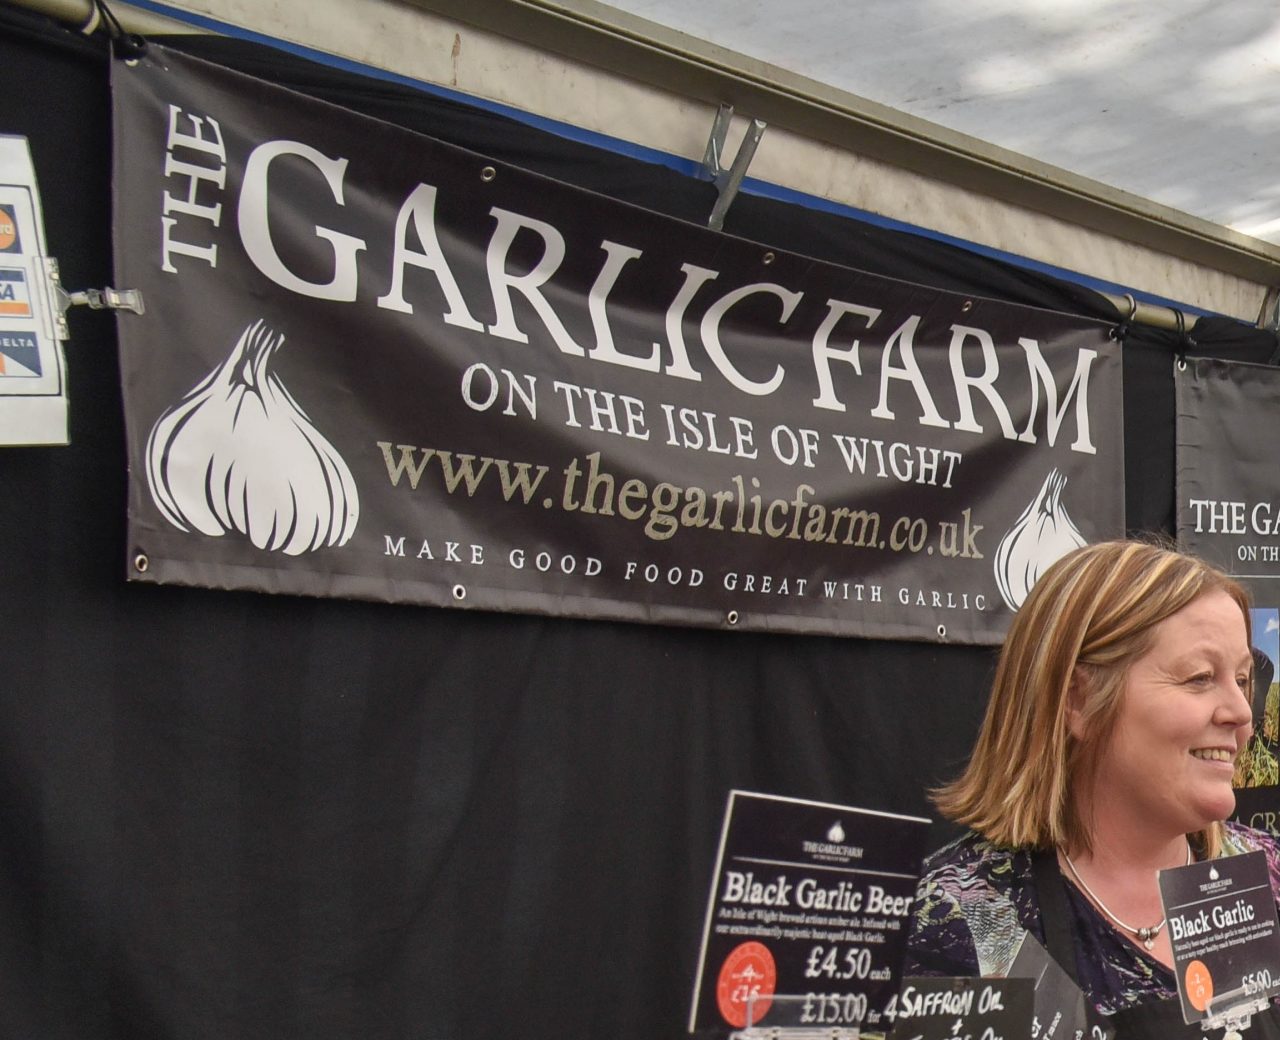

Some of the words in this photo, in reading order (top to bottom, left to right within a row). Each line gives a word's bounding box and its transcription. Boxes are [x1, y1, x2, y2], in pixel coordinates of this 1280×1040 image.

[162, 104, 226, 273] THE
[461, 362, 539, 420] ON
[553, 381, 650, 441] THE
[661, 404, 759, 461] ISLE
[771, 425, 819, 468] OF
[832, 435, 962, 490] WIGHT
[377, 442, 984, 559] www.thegarlicfarm.co.uk
[1189, 499, 1247, 533] THE
[1237, 545, 1256, 561] ON
[385, 536, 485, 565] MAKE
[509, 549, 603, 576] GOOD
[625, 562, 704, 587] FOOD
[724, 572, 808, 596] GREAT
[824, 581, 883, 603] WITH
[899, 588, 987, 611] GARLIC
[723, 872, 792, 906] Black
[796, 879, 862, 912] Garlic
[865, 886, 914, 916] Beer
[1170, 908, 1212, 941] Black
[1212, 899, 1255, 930] Garlic
[805, 946, 871, 979] £4.50
[869, 967, 891, 980] each
[1241, 969, 1272, 996] £5.00
[800, 992, 867, 1023] £15.00
[867, 1011, 881, 1023] for
[884, 994, 898, 1021] 4
[899, 986, 974, 1019] SAFFRON
